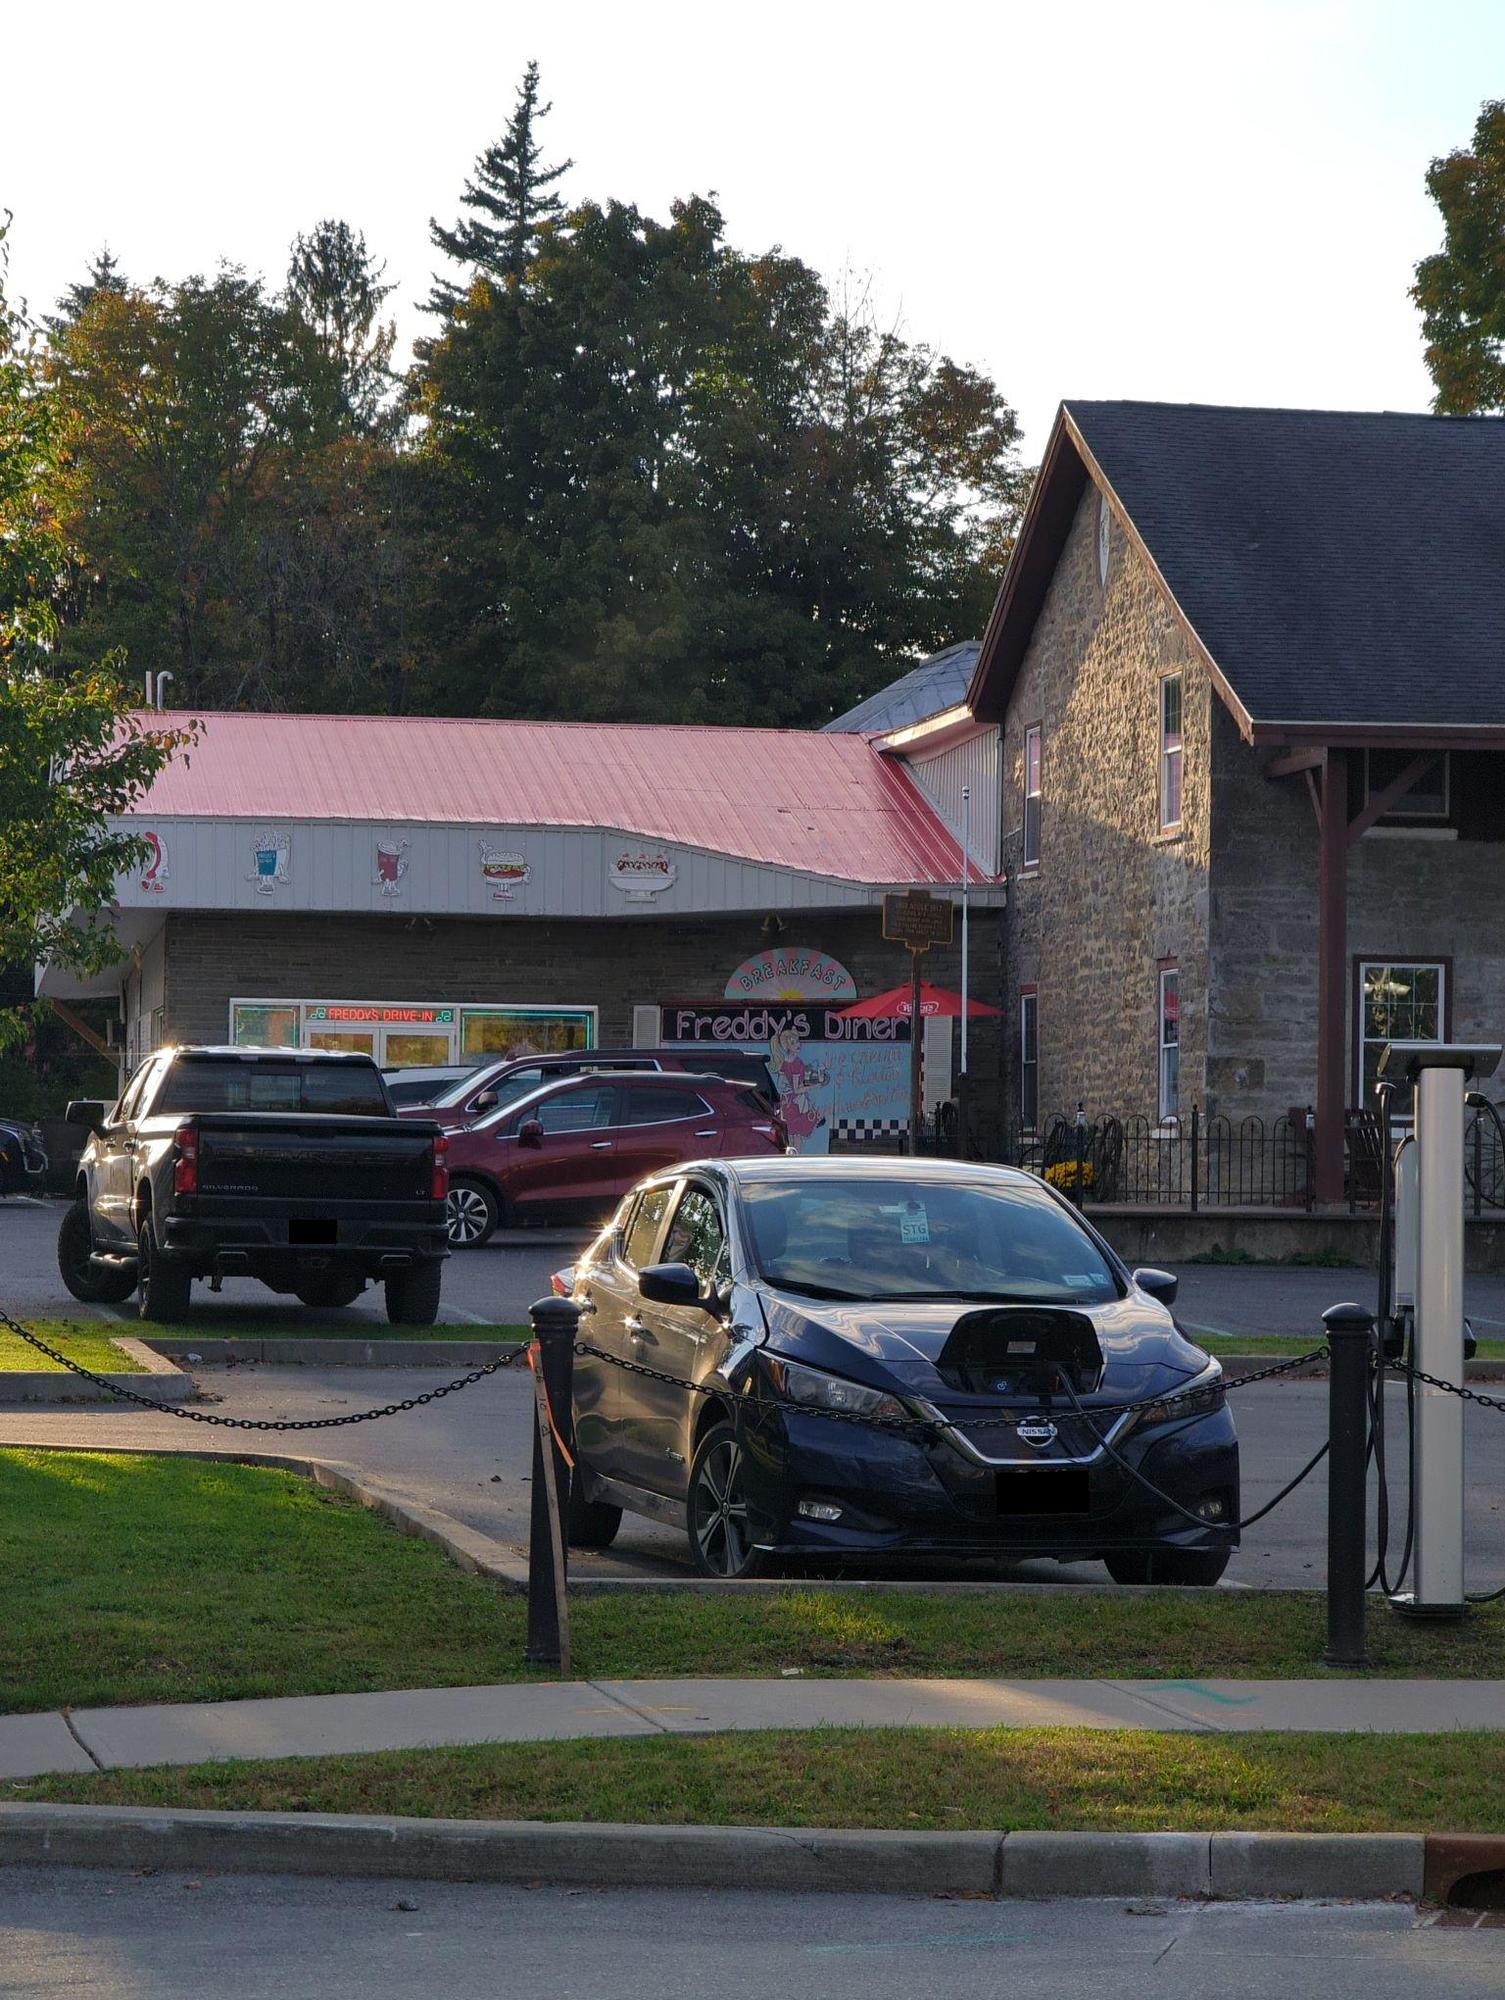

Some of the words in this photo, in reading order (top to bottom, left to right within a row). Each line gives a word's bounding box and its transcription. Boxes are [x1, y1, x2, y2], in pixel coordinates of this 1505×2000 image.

[740, 958, 846, 991] BREAKFAST
[328, 1007, 378, 1021] FREDDY'S
[382, 1010, 433, 1021] DRIVE-IN
[676, 1010, 810, 1040] Freddy's
[824, 1011, 909, 1040] Diner
[903, 1224, 926, 1235] STG
[1022, 1427, 1055, 1435] NISSAN
